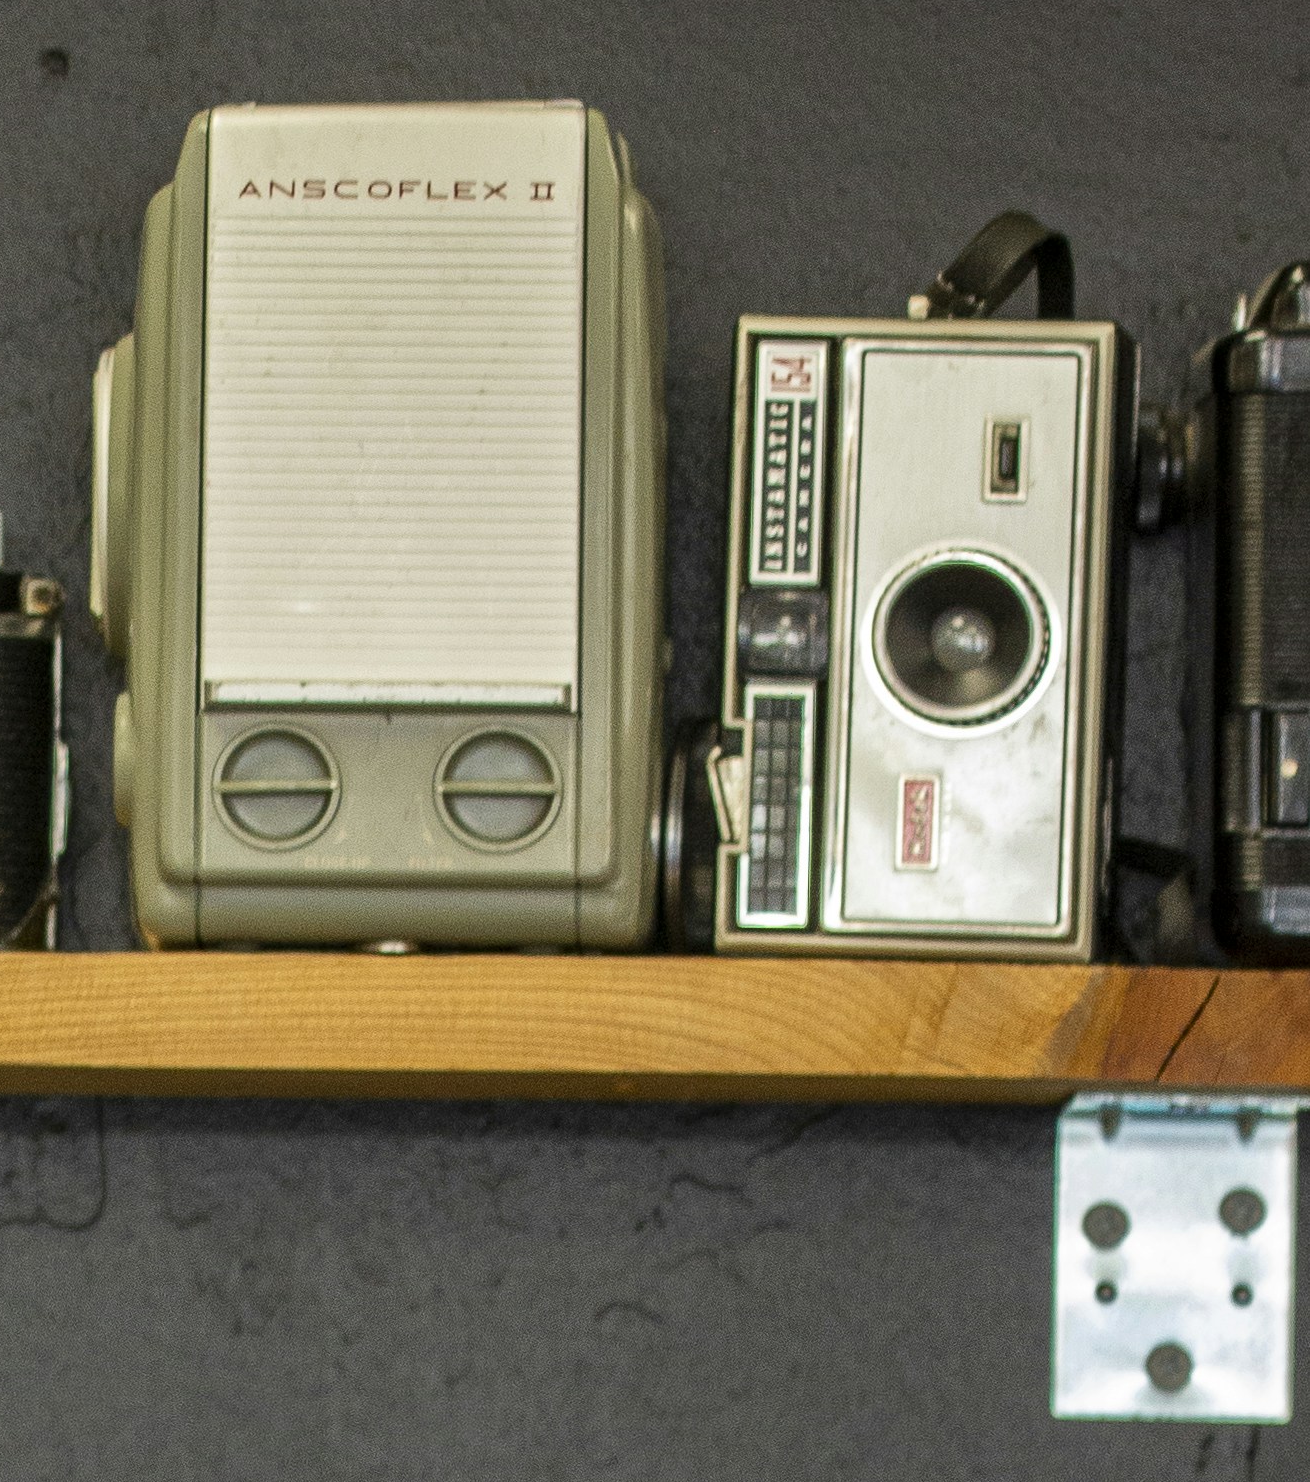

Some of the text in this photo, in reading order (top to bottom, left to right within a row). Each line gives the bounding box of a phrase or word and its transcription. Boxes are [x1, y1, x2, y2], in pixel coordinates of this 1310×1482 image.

[239, 180, 555, 201] ANSCOFLEX II
[764, 403, 788, 570] INSTAMATIC
[797, 414, 812, 557] CAMERA
